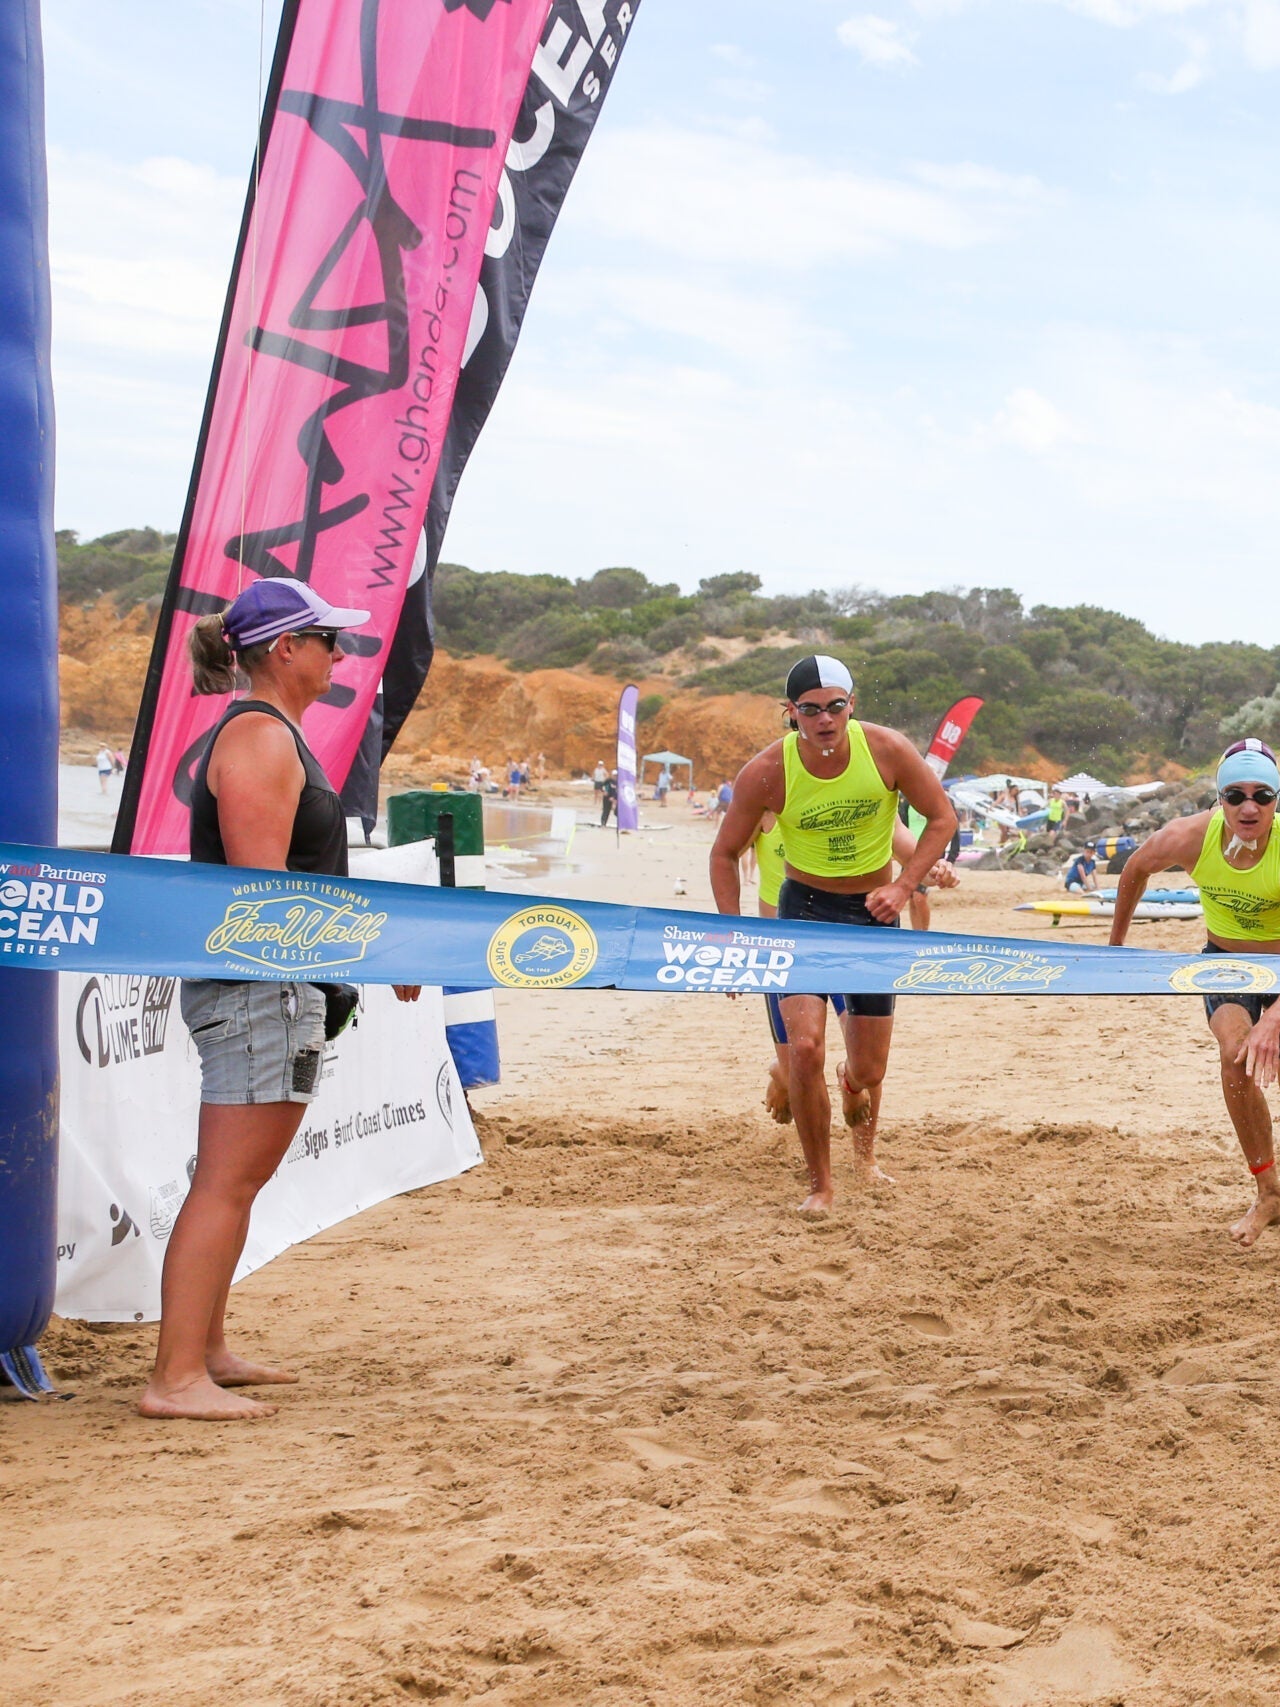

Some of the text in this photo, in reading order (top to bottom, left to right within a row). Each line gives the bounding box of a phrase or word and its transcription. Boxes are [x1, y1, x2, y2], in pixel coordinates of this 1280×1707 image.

[366, 168, 482, 590] www.ghanda.com
[0, 879, 104, 915] ORLD
[233, 879, 371, 908] WORLD'S FIRST IRONMAN
[0, 909, 99, 945] CEAN
[519, 914, 579, 933] TORQUAY
[3, 942, 60, 956] ERIES
[261, 945, 322, 962] CLASSIC
[495, 940, 589, 986] SURF LIFE SAVING CLUB
[662, 942, 794, 970] WORLD
[966, 943, 997, 954] FIRST
[1000, 946, 1049, 964] IRONMAN
[656, 965, 789, 987] OCEAN
[104, 975, 141, 1011] CLUB
[111, 1008, 168, 1064] LIME GYM
[355, 1110, 382, 1139] Coast
[382, 1099, 426, 1130] Times
